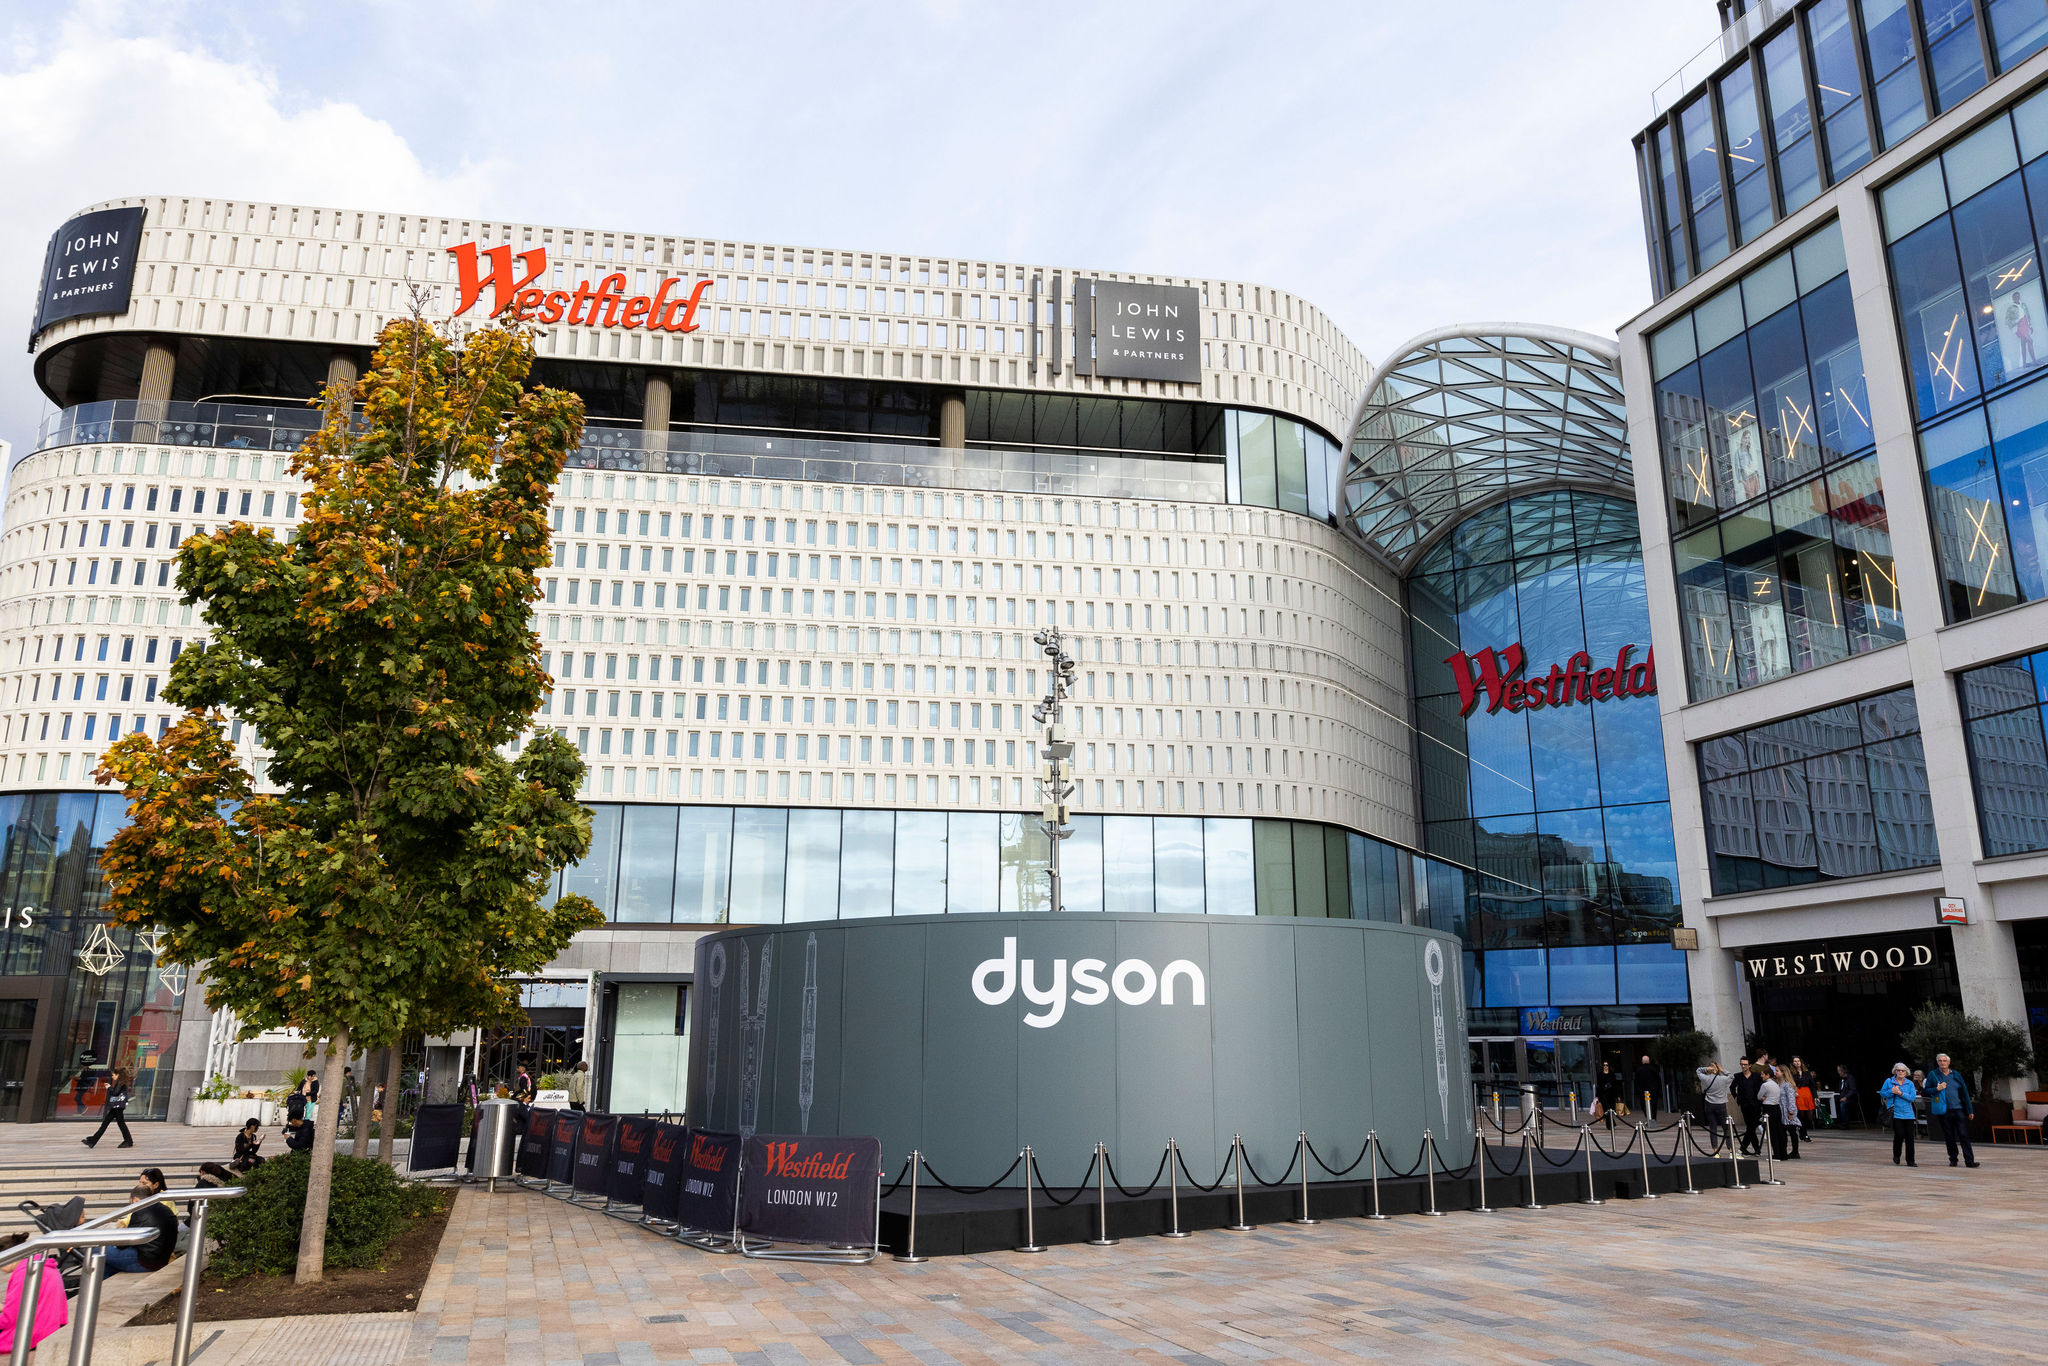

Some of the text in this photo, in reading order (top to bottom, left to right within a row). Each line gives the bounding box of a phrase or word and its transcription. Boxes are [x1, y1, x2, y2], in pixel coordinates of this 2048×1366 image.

[64, 230, 119, 256] JOHN
[56, 256, 120, 281] LEWIS
[52, 281, 114, 300] & PARTNERS
[445, 241, 714, 334] Westfield
[1116, 301, 1178, 318] JOHN
[1111, 324, 1185, 342] LEWIS
[1113, 348, 1184, 361] & PARTNERS
[1443, 641, 1658, 717] Westfield
[1748, 945, 1932, 978] WESTWOOD
[971, 936, 1206, 1029] dyson
[1526, 1011, 1585, 1031] Westfield
[689, 1134, 728, 1173] Westfield
[764, 1141, 856, 1180] Westfield
[767, 1188, 838, 1207] LONDON W12
